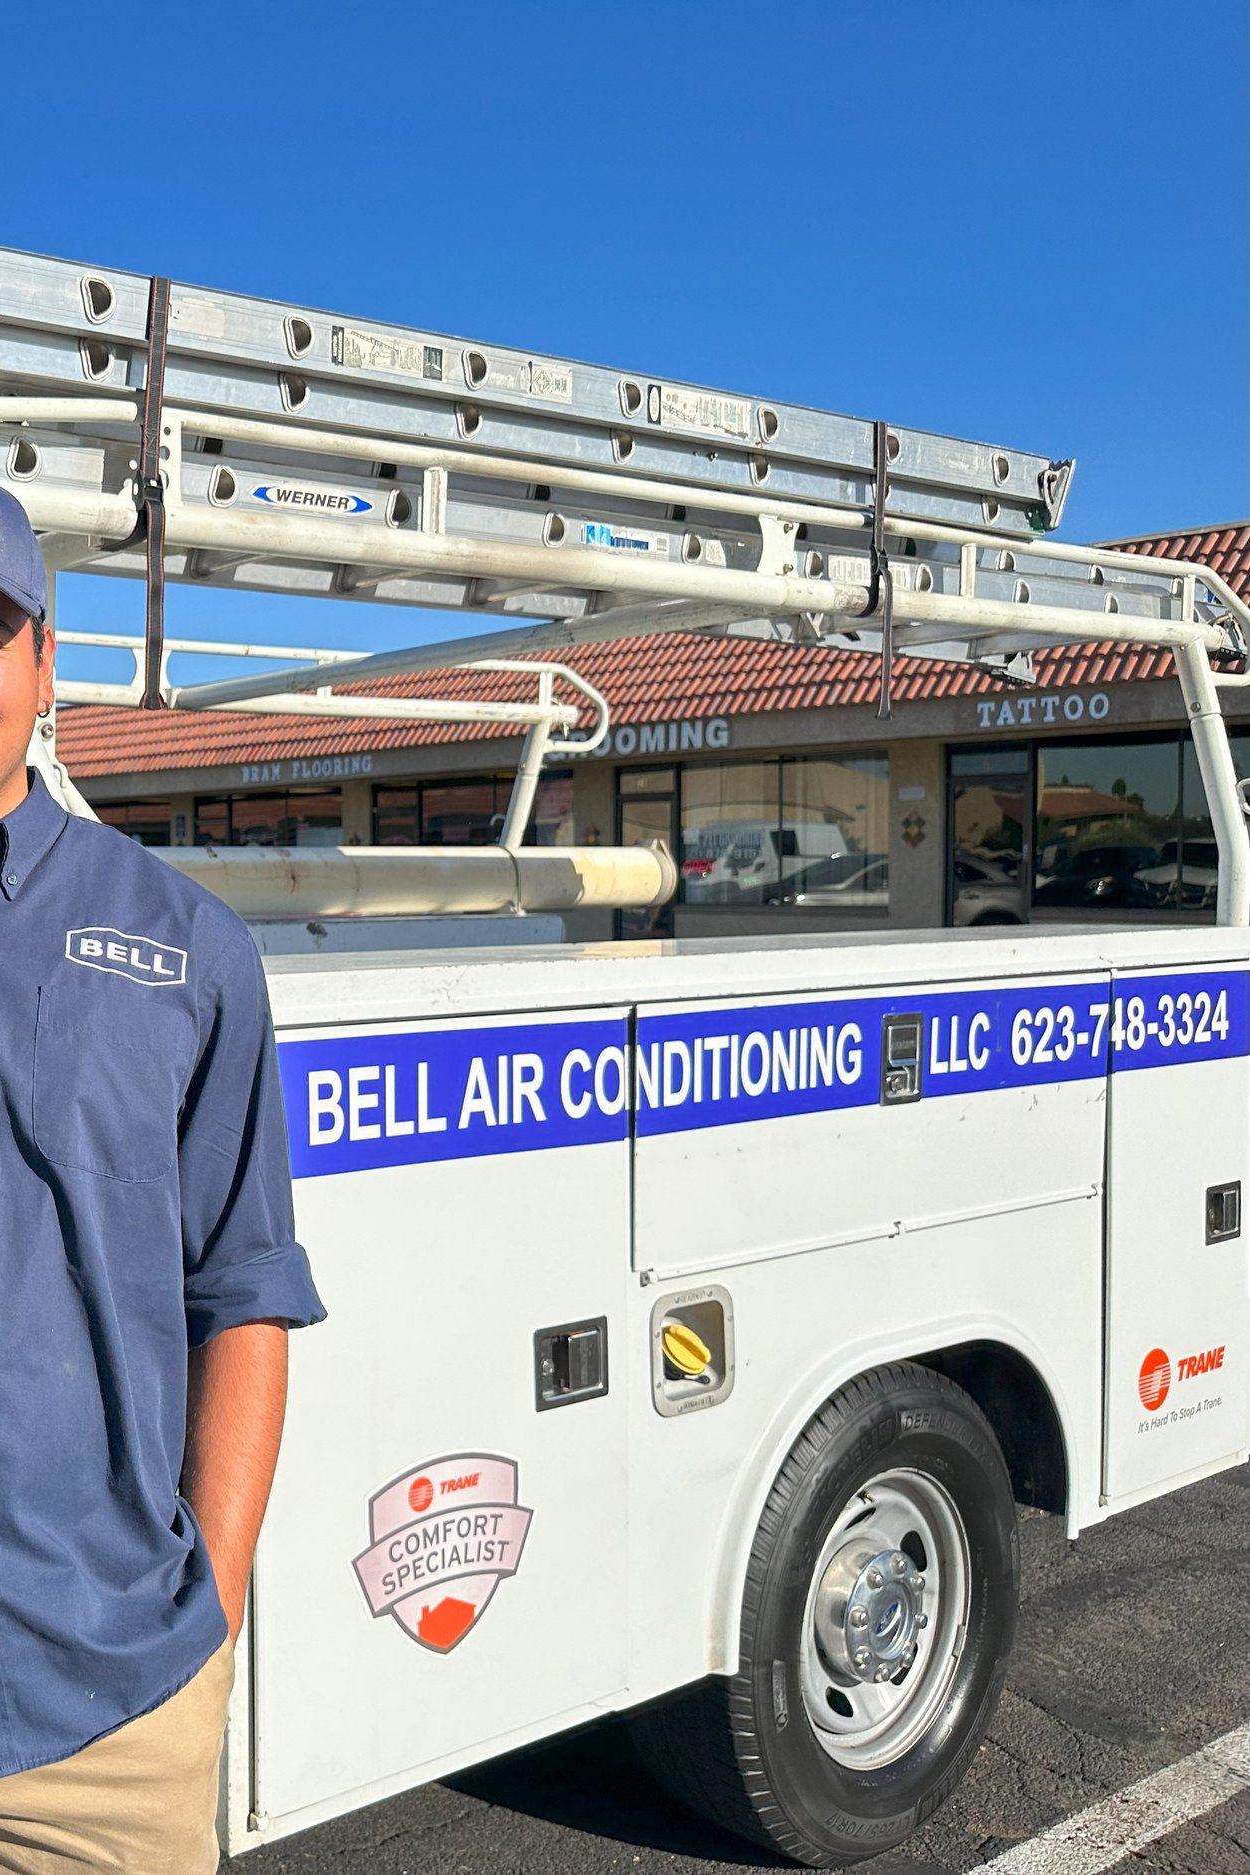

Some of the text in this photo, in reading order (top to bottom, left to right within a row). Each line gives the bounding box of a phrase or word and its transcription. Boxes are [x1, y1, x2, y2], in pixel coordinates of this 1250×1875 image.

[276, 488, 350, 510] WERNER
[977, 692, 1110, 728] TATTOO
[291, 755, 372, 779] FLOORING
[80, 938, 175, 976] BELL
[308, 990, 1229, 1147] BELL AIR CONDITIONING LLC 623-748-3324
[1178, 1346, 1225, 1382] TRANE
[1138, 1421, 1149, 1433] It's
[1150, 1413, 1169, 1430] Hard
[1170, 1411, 1178, 1423] To
[1179, 1407, 1195, 1418] Stop
[1195, 1402, 1202, 1413] A
[440, 1473, 480, 1495] TRANE
[389, 1513, 503, 1563] COMFORT
[382, 1540, 510, 1595] SPECIALIST
